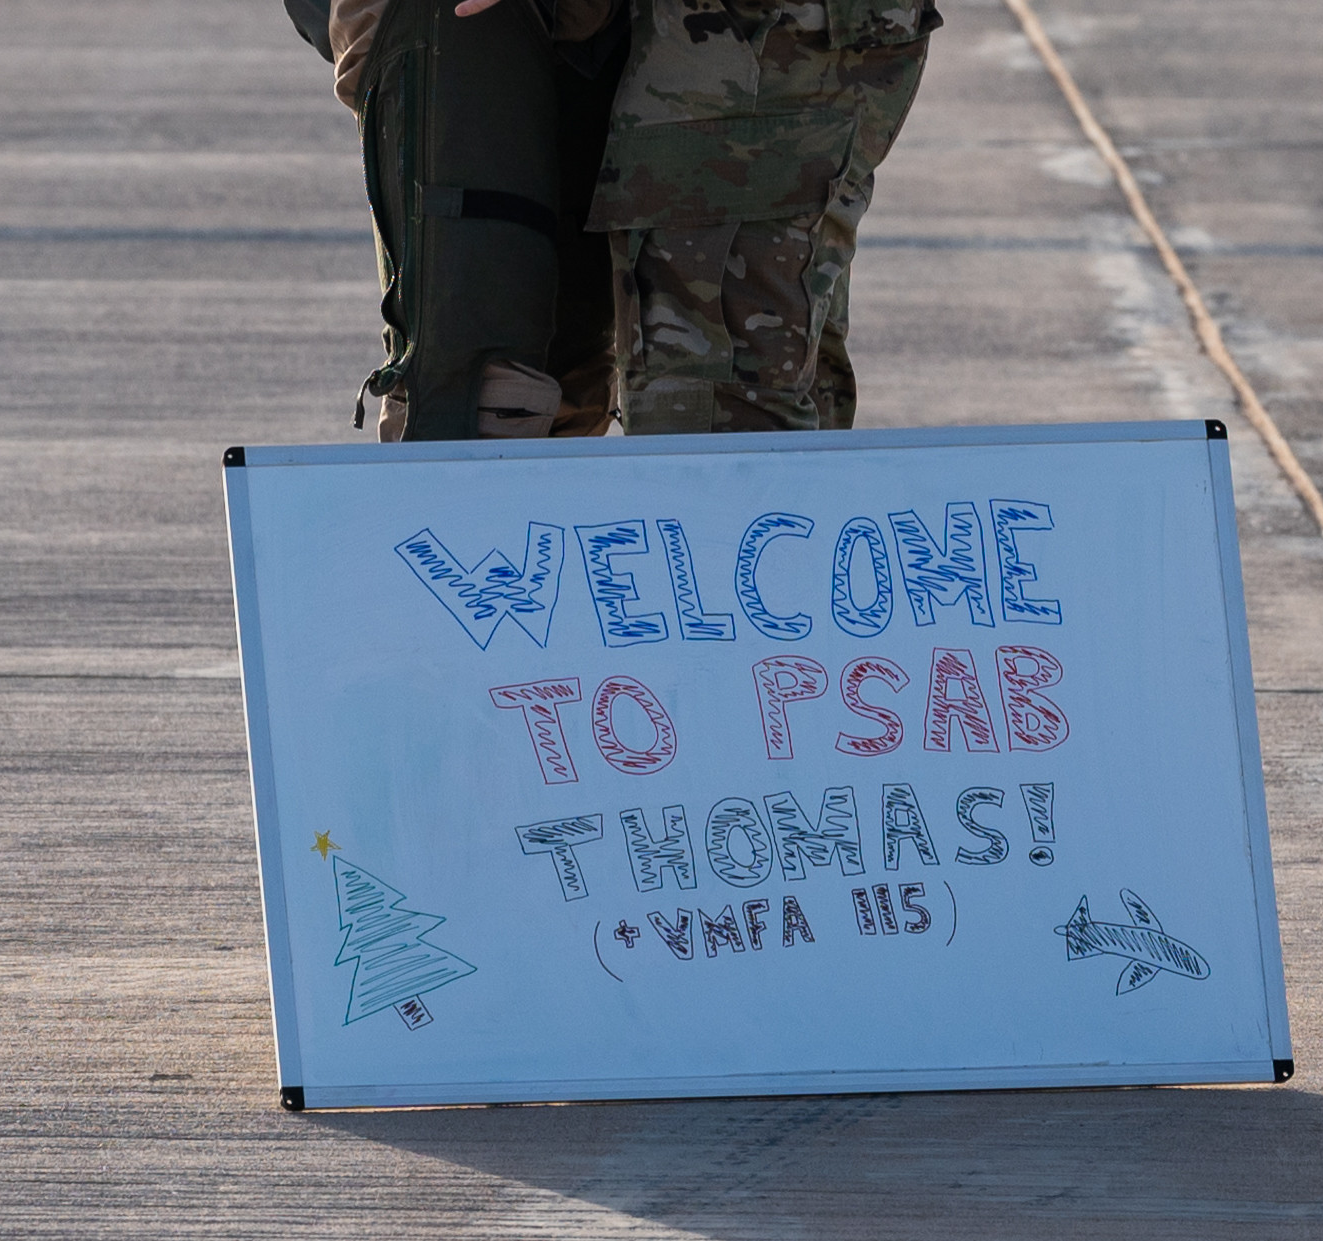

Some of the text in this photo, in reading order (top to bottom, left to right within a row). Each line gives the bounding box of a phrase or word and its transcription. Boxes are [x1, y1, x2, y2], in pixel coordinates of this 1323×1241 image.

[393, 498, 1063, 651] WELCOME
[488, 645, 1070, 784] TO PSAB
[514, 782, 1055, 902] THOMAS!
[646, 895, 815, 960] VMFA
